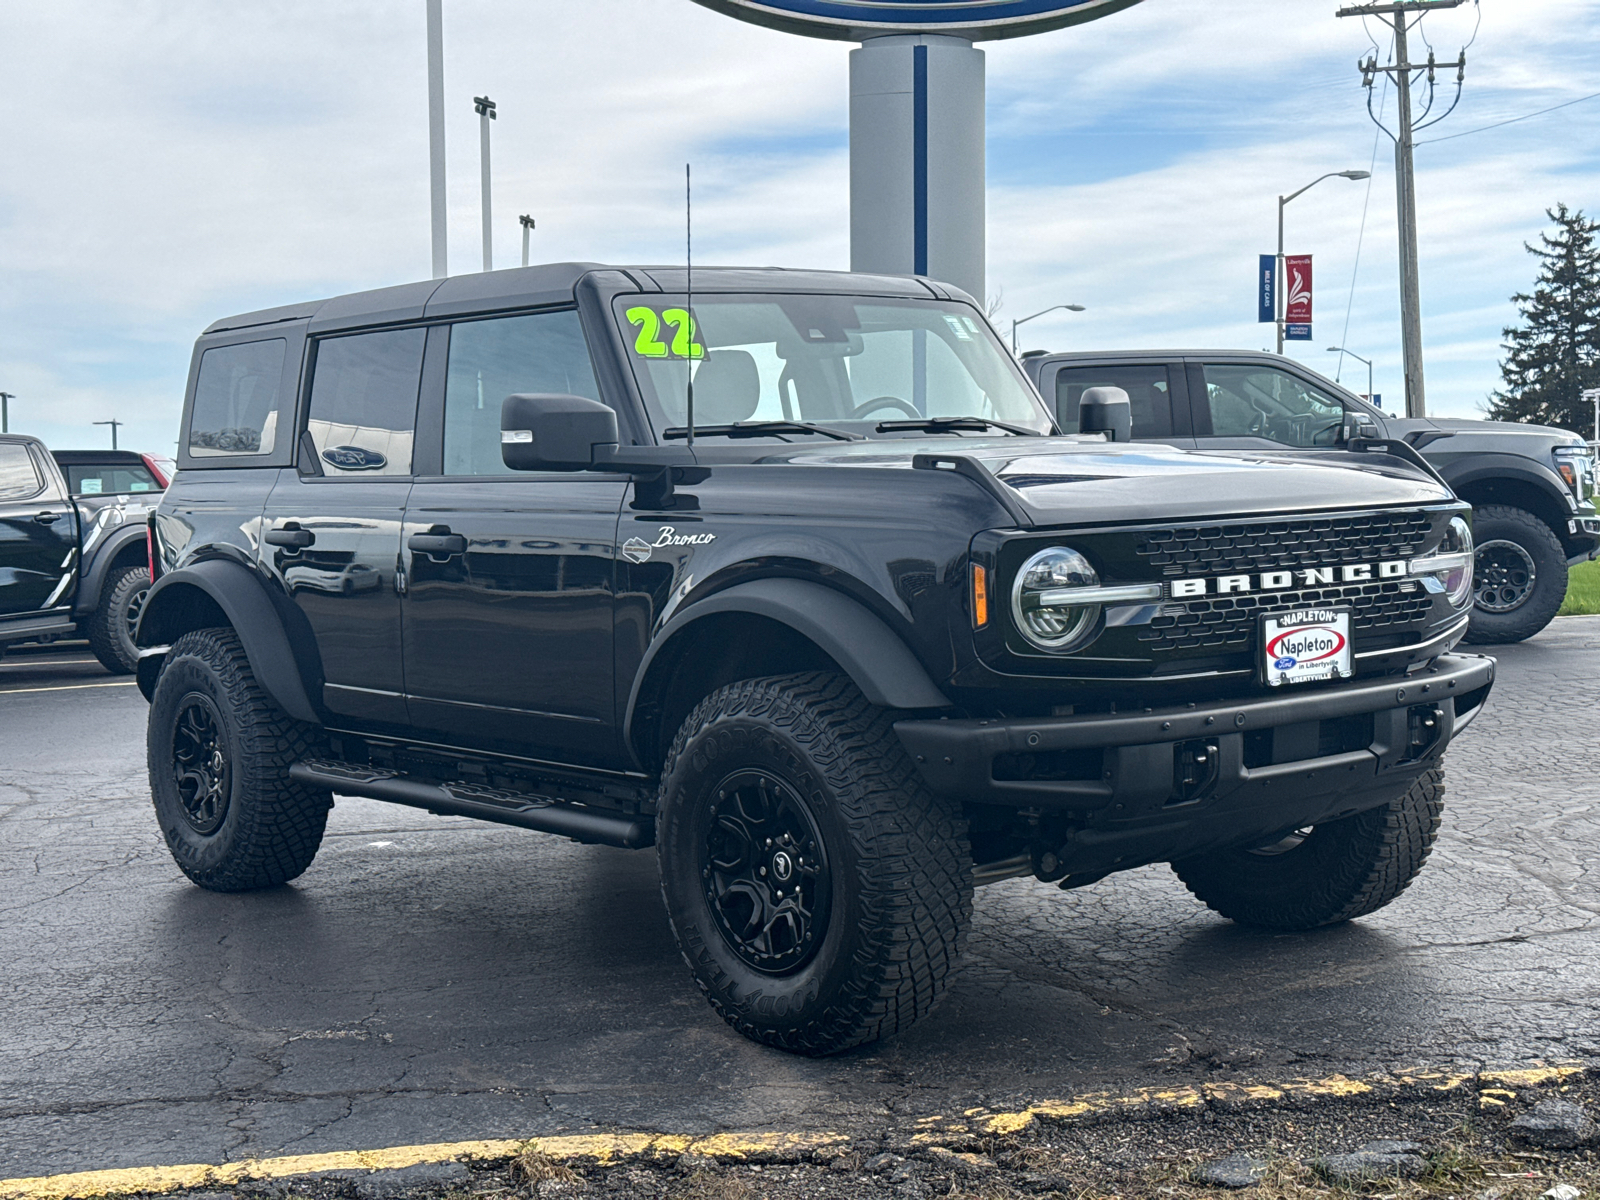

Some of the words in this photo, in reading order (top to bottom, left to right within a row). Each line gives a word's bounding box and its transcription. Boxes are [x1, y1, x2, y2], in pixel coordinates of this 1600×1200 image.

[1264, 284, 1271, 292] OF
[625, 306, 705, 358] 22
[651, 526, 717, 548] Bronco
[1170, 560, 1407, 598] BRONCO
[1282, 610, 1334, 626] NAPLETON
[1280, 636, 1333, 657] Napleton
[1277, 658, 1293, 669] Ford
[1305, 659, 1339, 669] Libertyville
